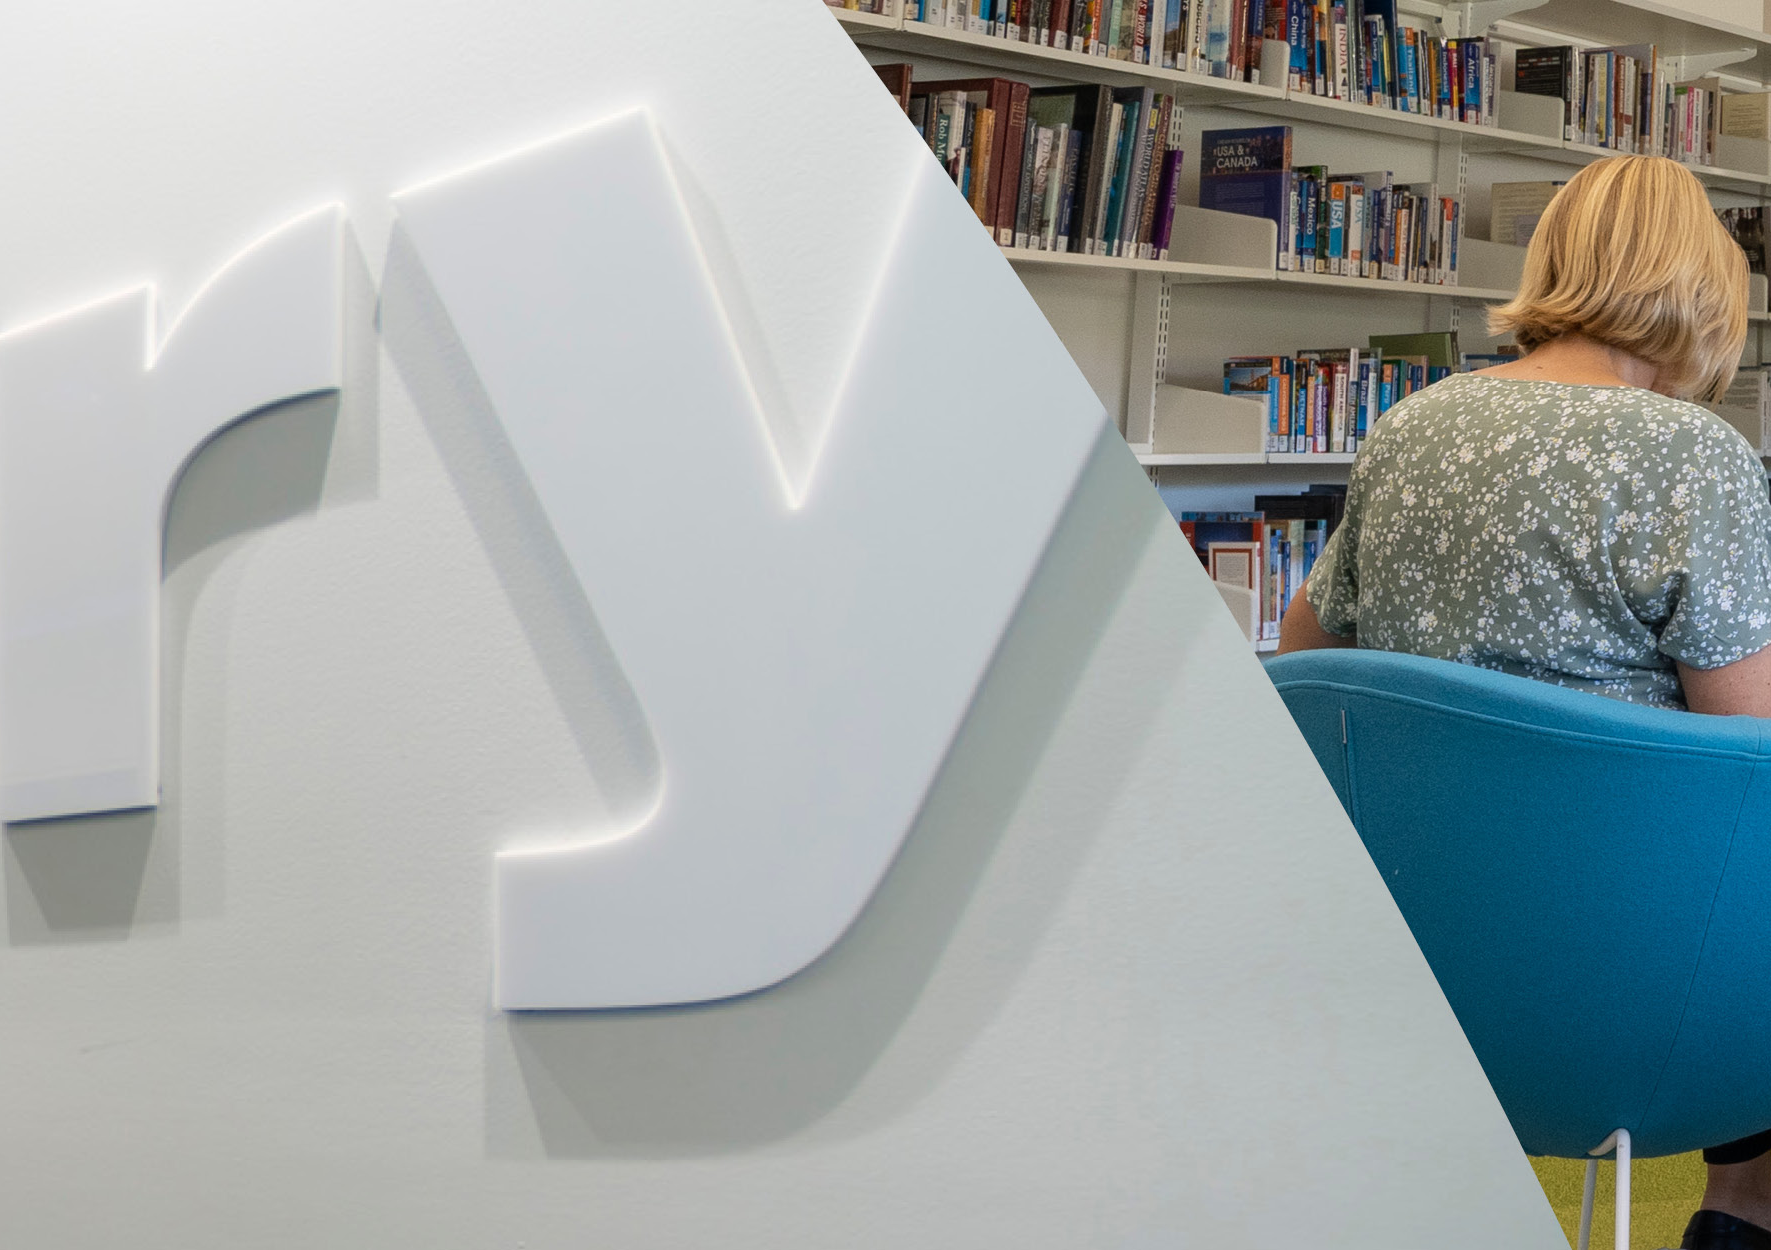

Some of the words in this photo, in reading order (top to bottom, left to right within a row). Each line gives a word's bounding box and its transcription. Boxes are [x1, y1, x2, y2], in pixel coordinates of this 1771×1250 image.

[1136, 14, 1147, 45] WORLD
[1291, 15, 1300, 46] China
[1339, 28, 1348, 66] INDIA
[1407, 49, 1416, 94] Thailand
[1467, 58, 1476, 89] Africa
[938, 119, 949, 140] Rob
[1142, 133, 1155, 169] WORLD
[1216, 156, 1259, 169] CANADA
[1217, 145, 1235, 157] USA
[1237, 144, 1244, 156] &
[1138, 170, 1149, 198] ATLAS
[1307, 197, 1316, 235] Mexico
[1331, 200, 1344, 229] USA
[1355, 199, 1364, 224] USA
[1360, 380, 1369, 406] Brazil
[1349, 405, 1357, 437] AMERICA
